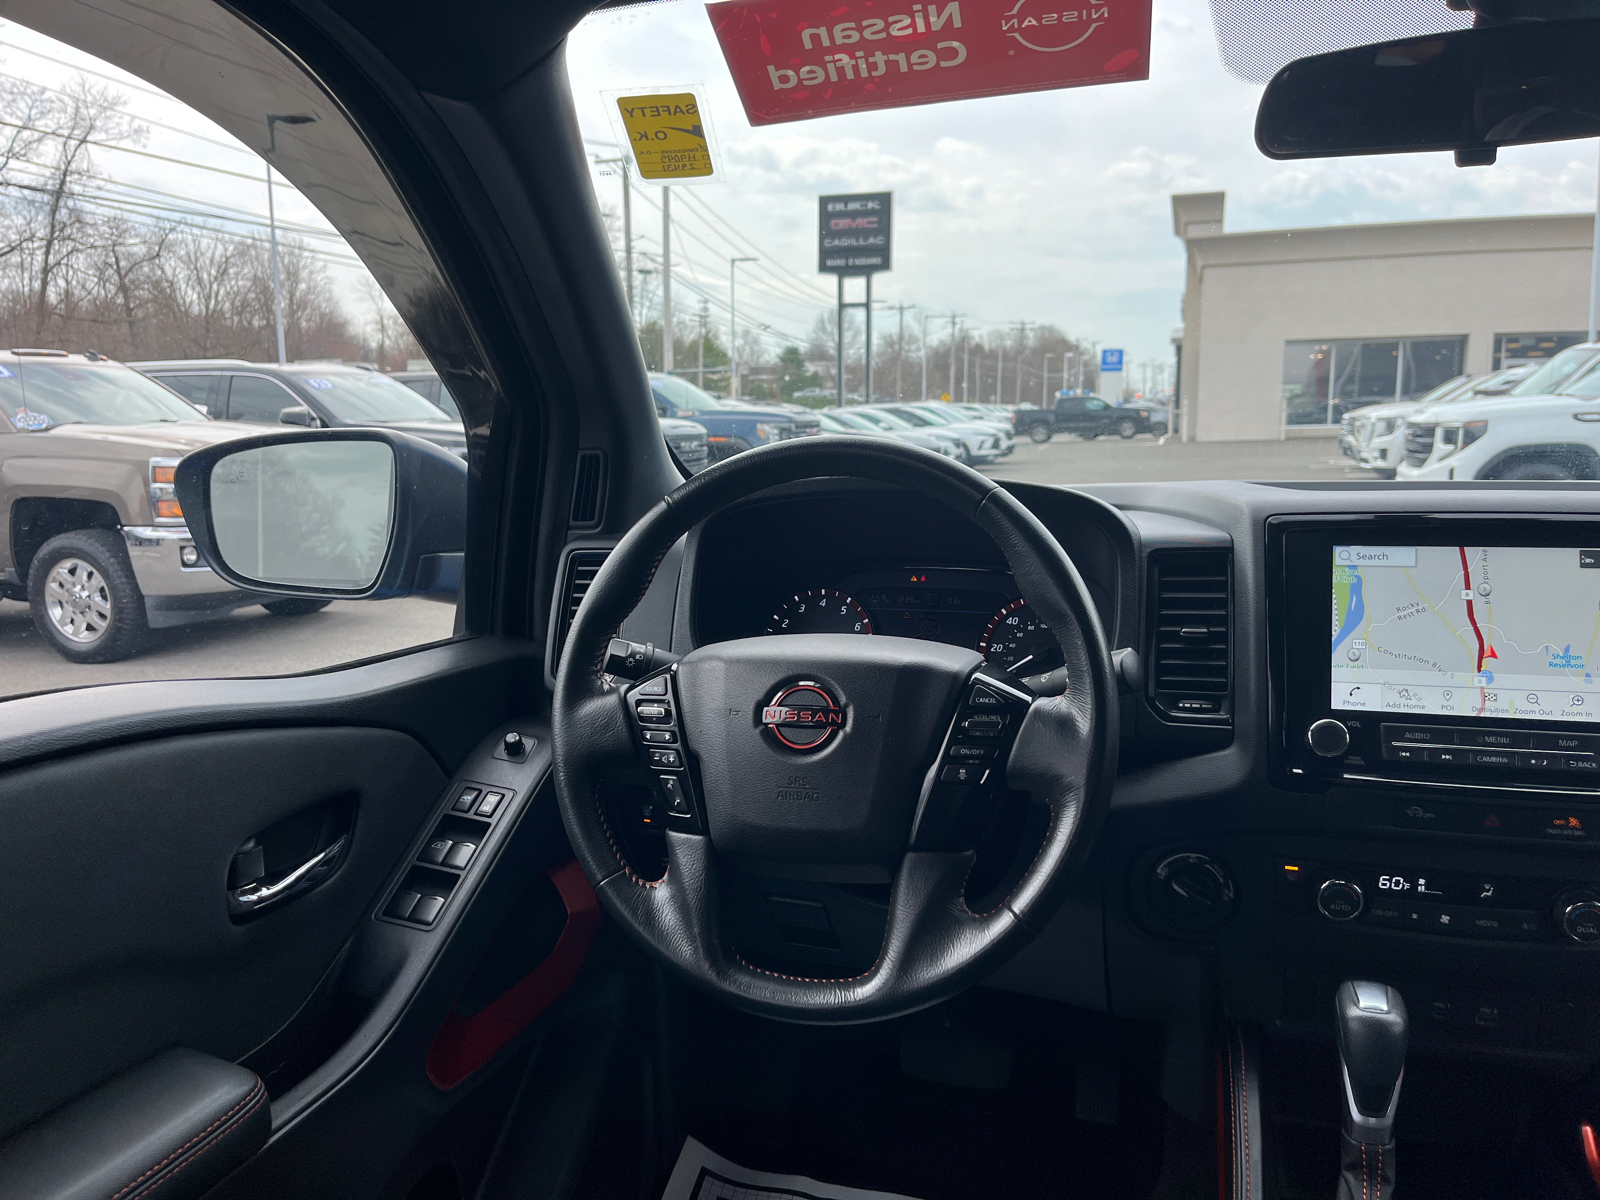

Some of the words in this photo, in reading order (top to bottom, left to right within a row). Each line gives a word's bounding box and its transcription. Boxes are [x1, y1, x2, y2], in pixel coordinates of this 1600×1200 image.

[827, 201, 881, 212] BUICK
[830, 217, 879, 230] GMC
[823, 236, 886, 247] CADILLAC
[1356, 552, 1389, 560] Search
[799, 604, 805, 612] 3
[841, 606, 847, 614] 5
[1396, 601, 1420, 612] Rocky
[1397, 611, 1415, 621] Rest
[1416, 607, 1426, 615] Rd
[1006, 617, 1019, 625] 40
[855, 623, 861, 631] 6
[991, 644, 1003, 652] 20
[1378, 647, 1430, 665] Constitution
[1431, 662, 1448, 676] Blvd
[765, 710, 842, 723] NISSAN
[787, 776, 808, 787] SRS
[776, 790, 820, 802] AIRBAG
